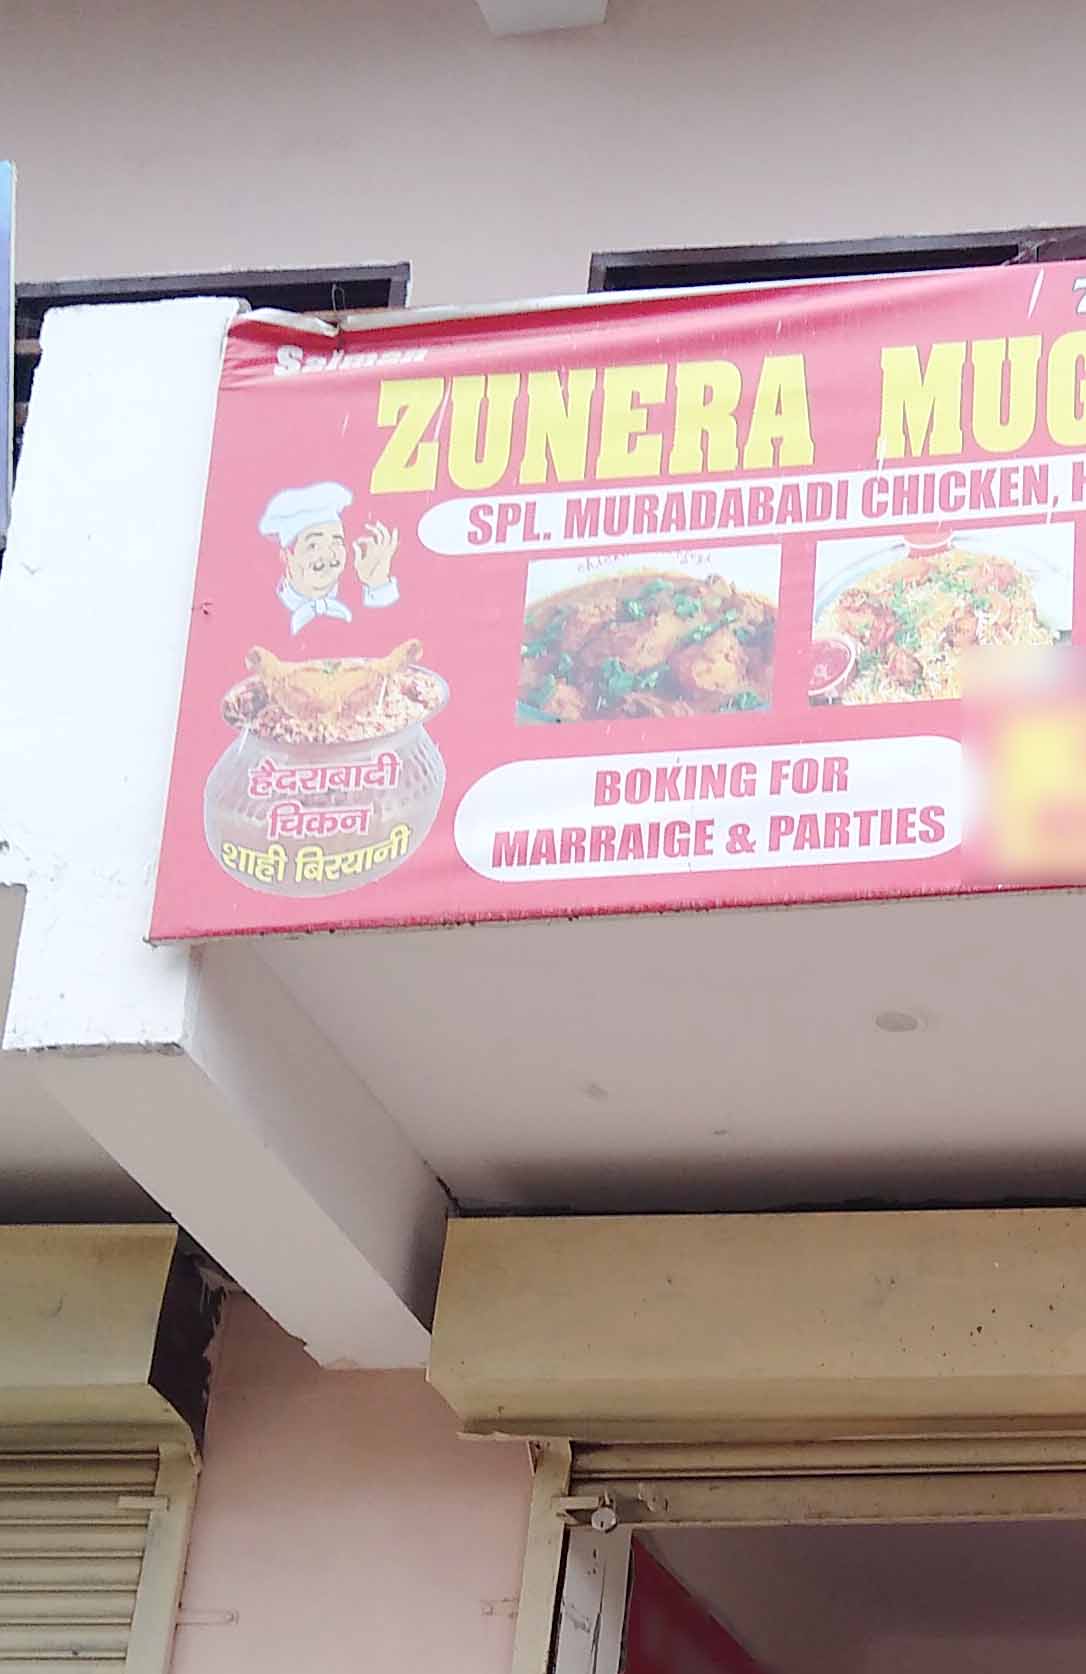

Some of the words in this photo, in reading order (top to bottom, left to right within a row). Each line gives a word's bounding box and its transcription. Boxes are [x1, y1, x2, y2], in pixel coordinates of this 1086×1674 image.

[369, 353, 815, 495] ZUNERA
[466, 503, 553, 546] SPL.
[563, 479, 850, 540] MURADABADI
[862, 460, 1059, 513] CHICKEN,
[247, 751, 402, 799] हैदराबादी
[594, 762, 757, 807] BOKING
[768, 756, 849, 796] FOR
[267, 799, 373, 841] चिकन
[491, 818, 717, 869] MARRAIGE
[727, 823, 757, 855] &
[768, 804, 946, 850] PARTIES
[222, 840, 288, 883] शाही
[294, 822, 413, 884] बिरयानी
